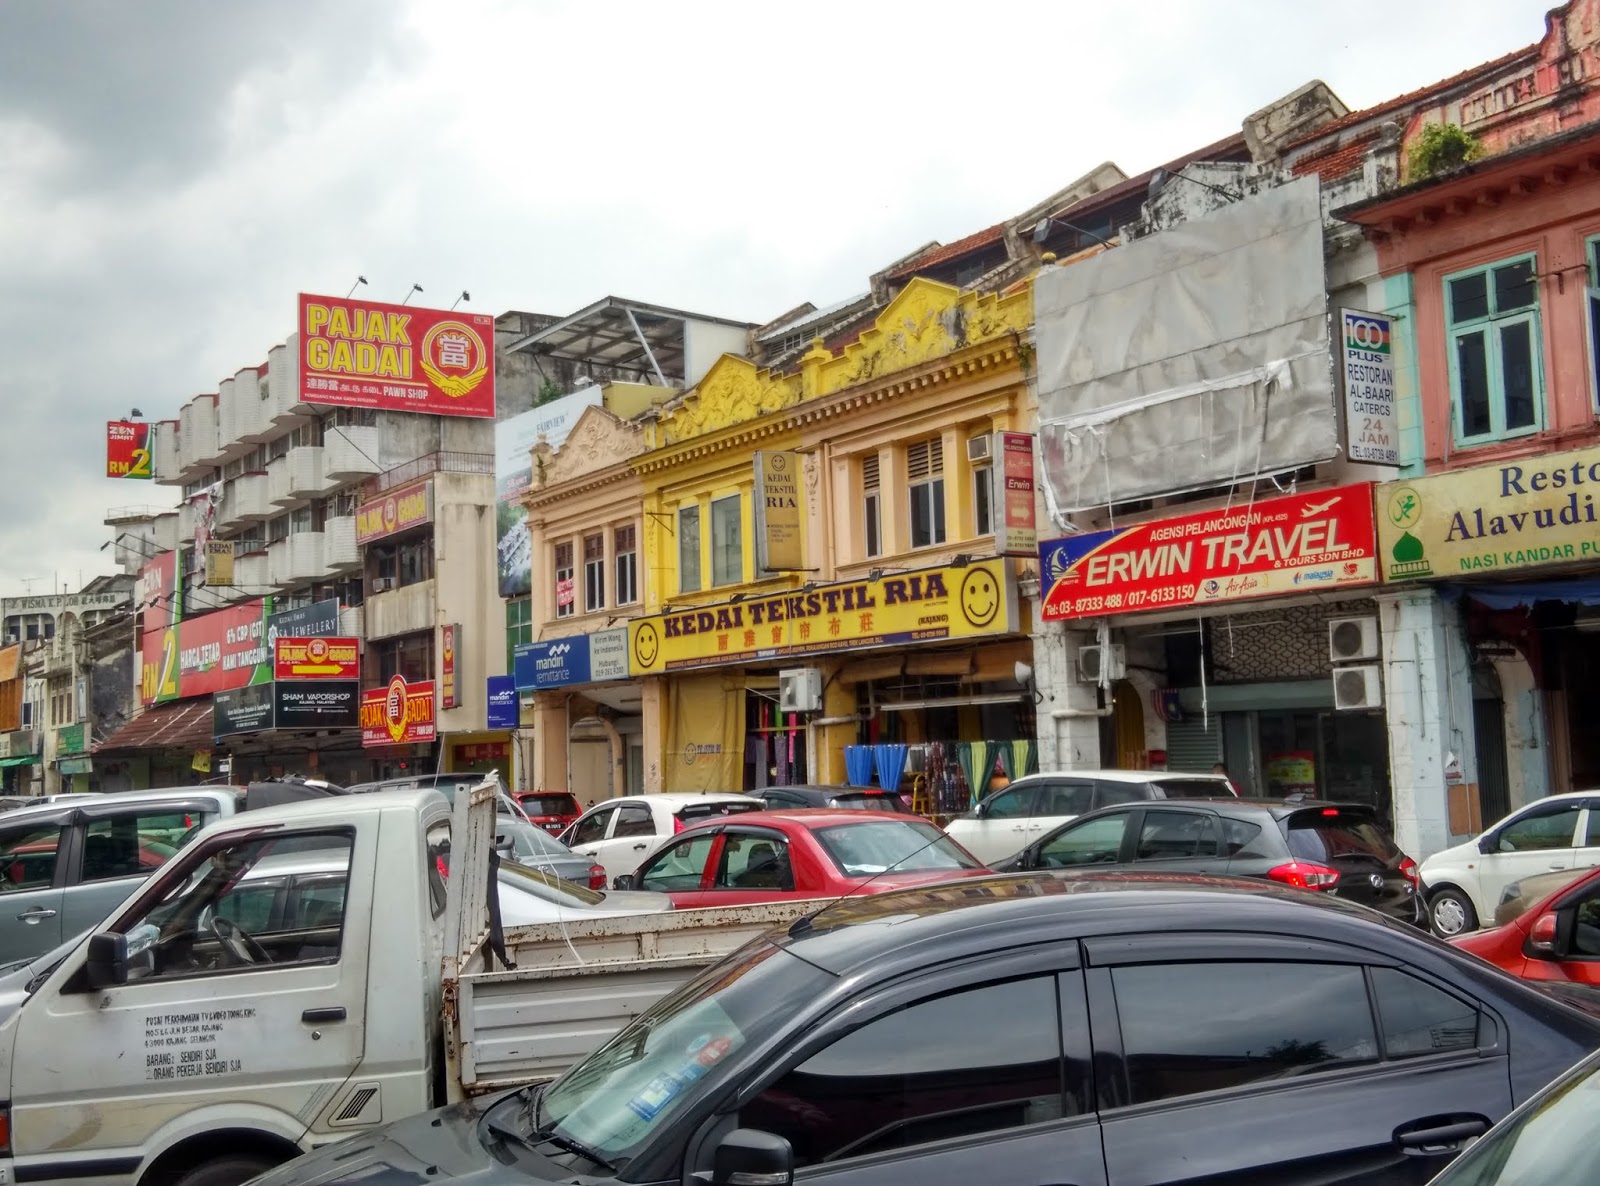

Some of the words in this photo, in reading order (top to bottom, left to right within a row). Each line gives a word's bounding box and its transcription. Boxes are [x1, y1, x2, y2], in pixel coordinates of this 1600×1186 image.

[307, 304, 412, 345] PAJAK
[1346, 318, 1383, 350] 100
[307, 337, 412, 379] GADAI
[1348, 350, 1382, 363] PLUS
[1348, 364, 1392, 386] RESTORAN
[384, 386, 406, 398] PAWN
[408, 389, 428, 400] SHOP
[1350, 384, 1394, 402] AL-BAARI
[536, 414, 565, 434] FAIRVIEW
[1363, 417, 1383, 432] 24
[1359, 432, 1389, 445] JAM
[110, 461, 129, 474] RM
[132, 449, 150, 474] 2
[768, 474, 790, 482] KEDAI
[1008, 479, 1030, 490] Erwin
[766, 486, 796, 494] TEKSTIL
[398, 490, 426, 525] GADAI
[766, 497, 796, 508] RIA
[356, 506, 384, 540] PAJAK
[1150, 526, 1184, 542] AGENSI
[1186, 512, 1262, 536] PELANCONGAN
[1086, 541, 1193, 587] ERWIN
[1202, 518, 1350, 570] TRAVEL
[1274, 559, 1282, 568] &
[1284, 554, 1316, 568] TOURS
[1318, 552, 1340, 562] SDN
[1342, 548, 1364, 559] BHD
[1460, 554, 1498, 570] NASI
[1504, 543, 1575, 564] KANDAR
[1303, 569, 1334, 580] malaysia
[22, 598, 46, 608] WISMA
[664, 606, 744, 638] KEDAI
[748, 584, 876, 625] TEKSTIL
[884, 573, 948, 606] RIA
[1046, 604, 1058, 616] Tel:
[1104, 594, 1122, 608] 488
[1128, 586, 1175, 606] 017-6133
[1176, 584, 1195, 599] 150
[292, 618, 336, 638] JEWELLERY
[918, 614, 949, 626] (KAJANG)
[226, 628, 236, 644] 6%
[237, 624, 248, 642] CBP
[180, 646, 200, 670] HARGA
[200, 642, 220, 666] TETAP
[222, 654, 236, 671] KAMI
[278, 648, 308, 661] PAJAK
[328, 648, 356, 661] GADAI
[536, 656, 564, 670] mandiri
[143, 660, 159, 700] RM
[162, 629, 176, 696] 2
[536, 669, 570, 684] remittance
[360, 702, 386, 728] PAJAK
[406, 697, 434, 722] GADAI
[416, 726, 426, 736] PAWN
[146, 1016, 162, 1026] PUSAT
[201, 1012, 208, 1022] TV
[213, 1010, 227, 1020] VIDEO
[182, 1025, 200, 1034] BESAR
[202, 1024, 224, 1032] KAJANG
[166, 1036, 188, 1046] KAJANG
[190, 1034, 216, 1044] SELANGOR
[180, 1050, 202, 1063] SENDIRI
[206, 1048, 216, 1060] SJA
[154, 1067, 174, 1080] ORANG
[176, 1064, 202, 1078] PEKERJA
[206, 1062, 228, 1074] SENDIRI
[230, 1060, 242, 1072] SJA
